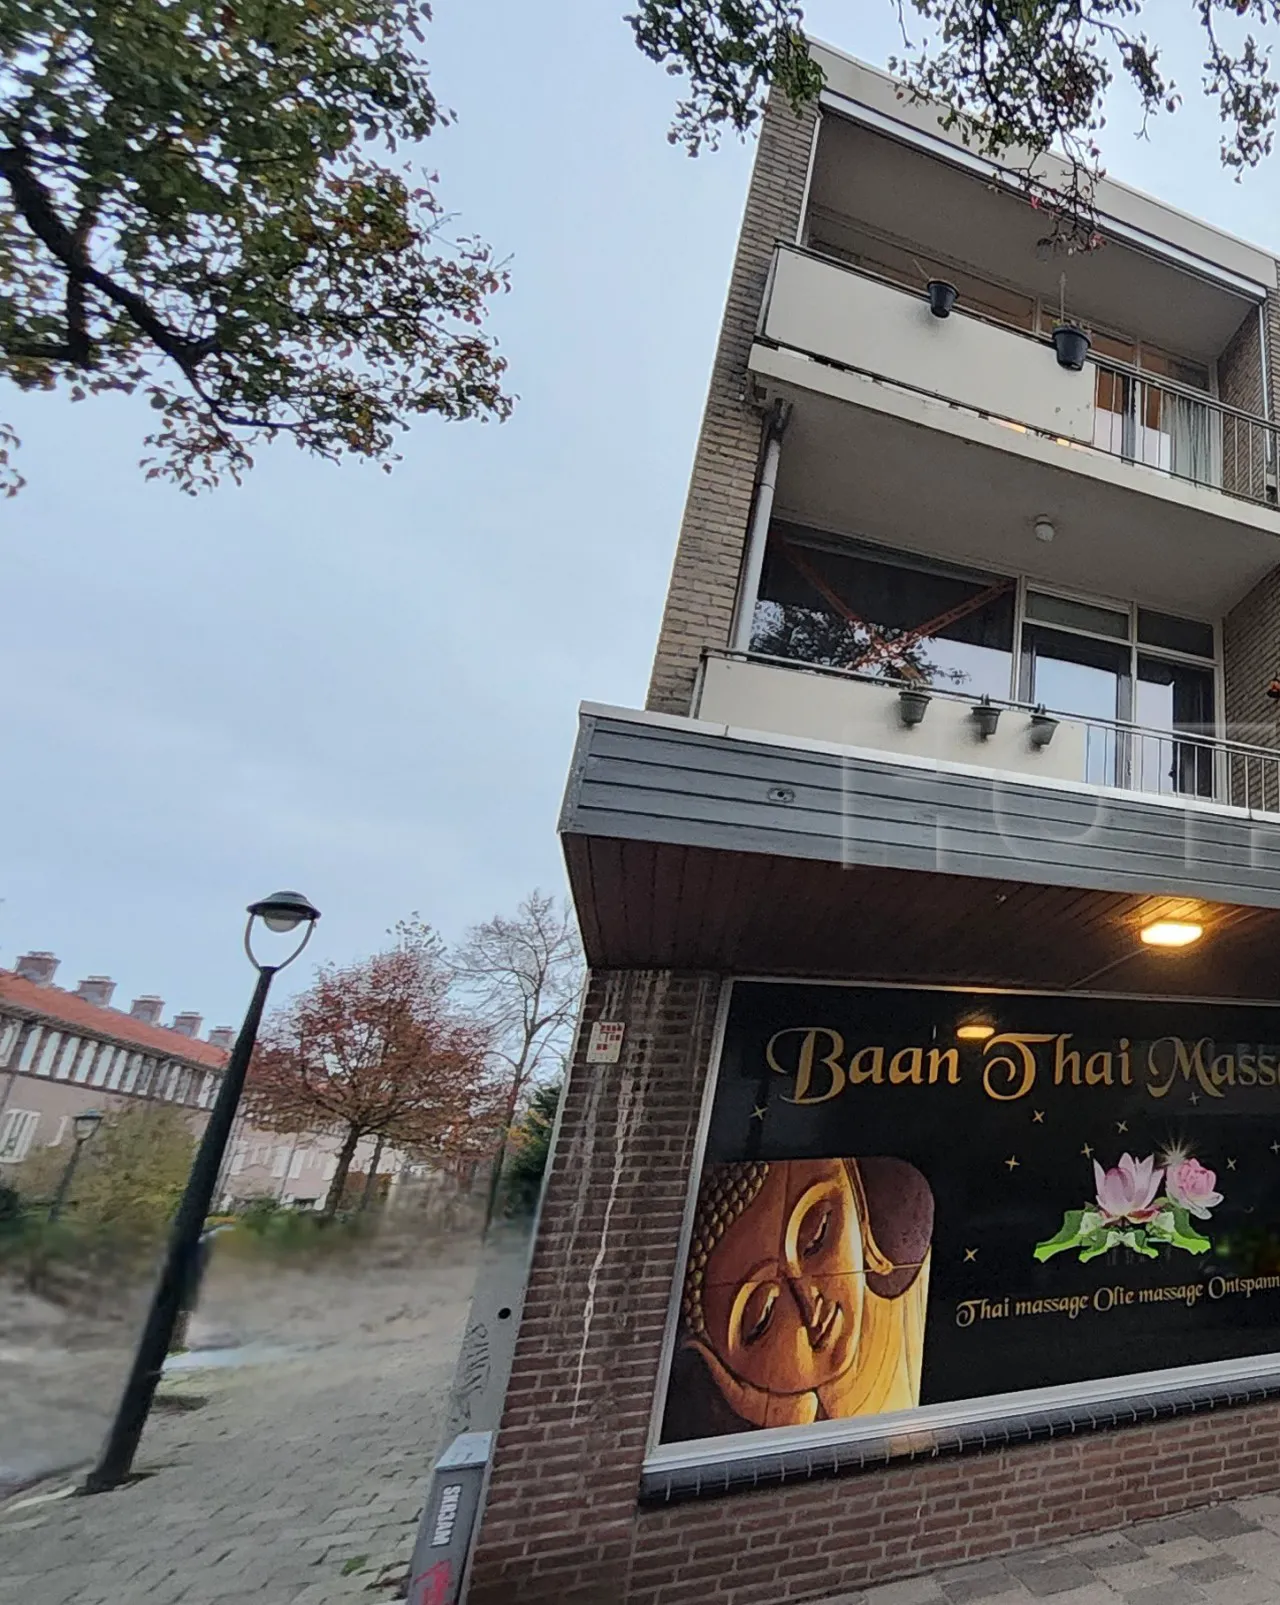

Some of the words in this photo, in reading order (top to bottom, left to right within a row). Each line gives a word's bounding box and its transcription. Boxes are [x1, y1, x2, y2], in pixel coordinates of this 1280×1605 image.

[766, 1026, 960, 1104] Baan
[982, 1032, 1133, 1100] Thai
[956, 1297, 1010, 1327] Thai
[1015, 1295, 1089, 1319] massage
[1094, 1285, 1135, 1311] Olie
[1139, 1283, 1203, 1306] massage
